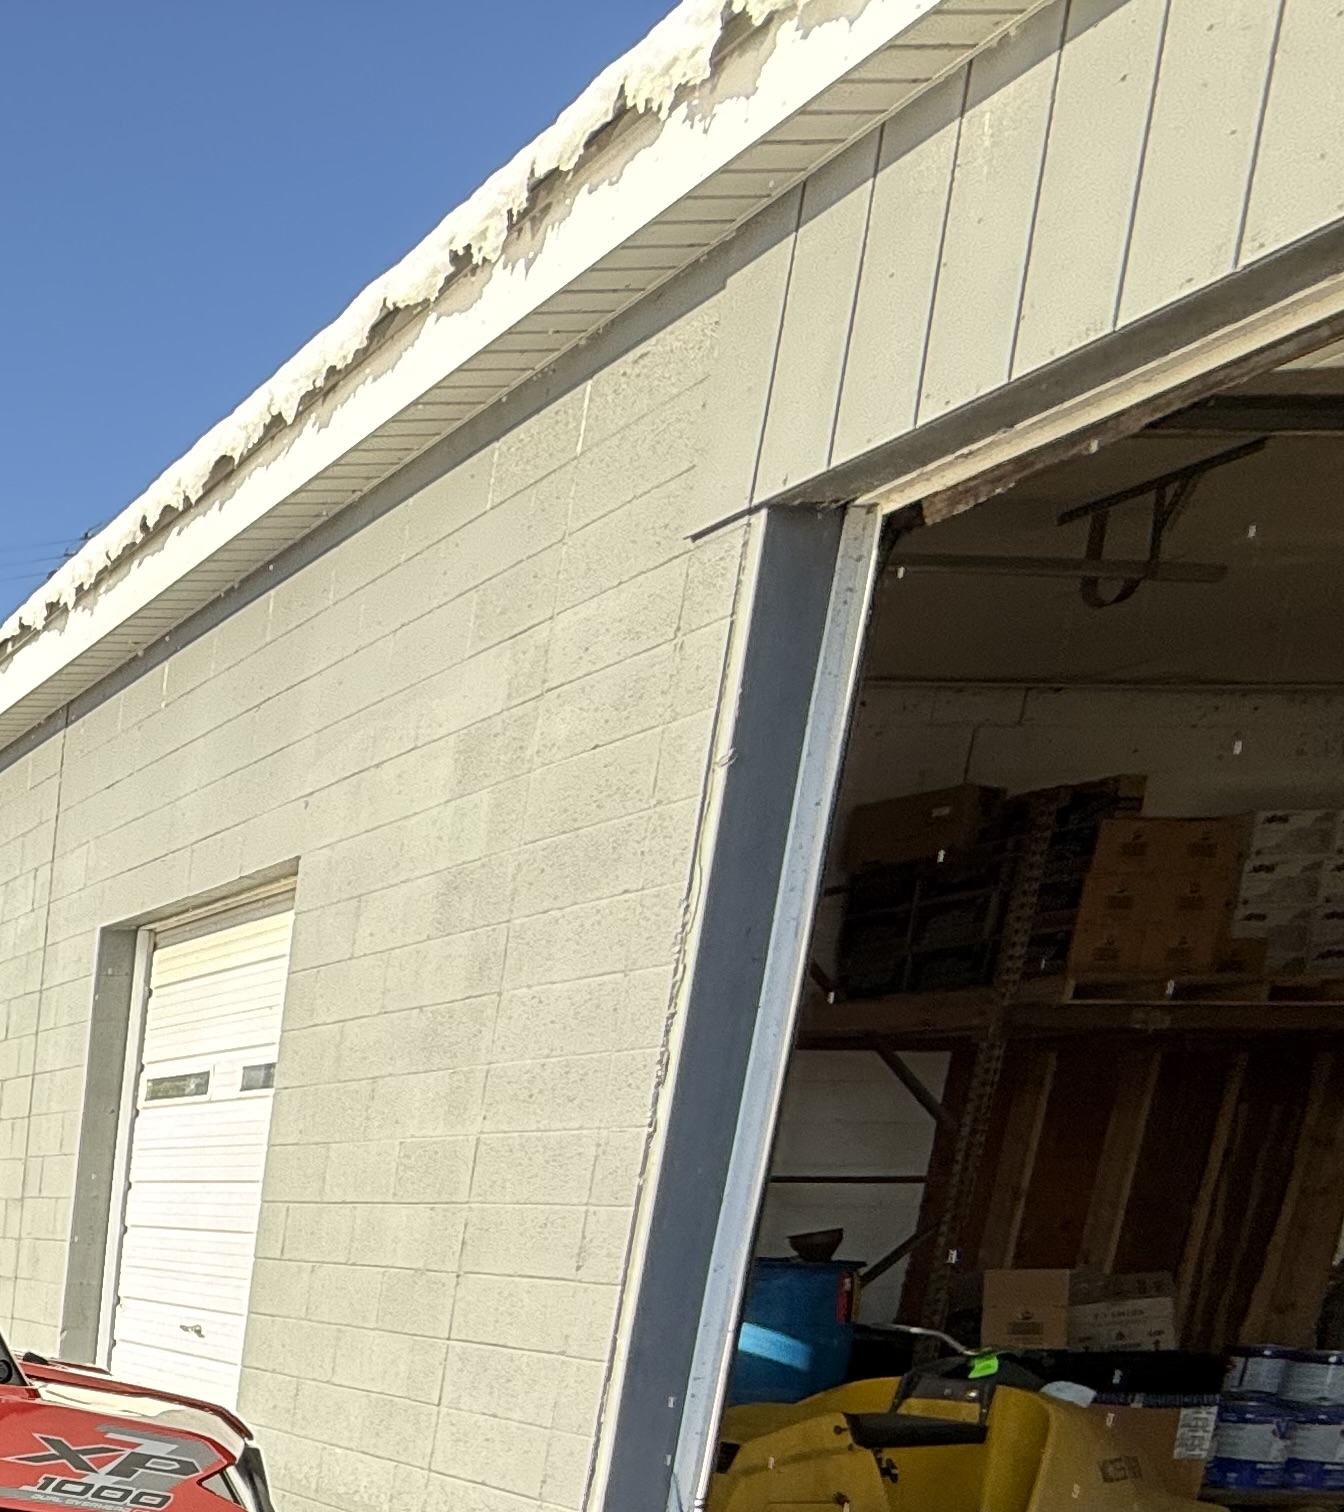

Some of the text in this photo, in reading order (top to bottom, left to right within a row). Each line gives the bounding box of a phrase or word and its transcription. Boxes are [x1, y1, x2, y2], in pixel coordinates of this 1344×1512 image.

[0, 1433, 203, 1481] XP
[30, 1493, 63, 1502] DUAL
[66, 1499, 131, 1512] OVERHEAD
[34, 1475, 174, 1510] 1000
